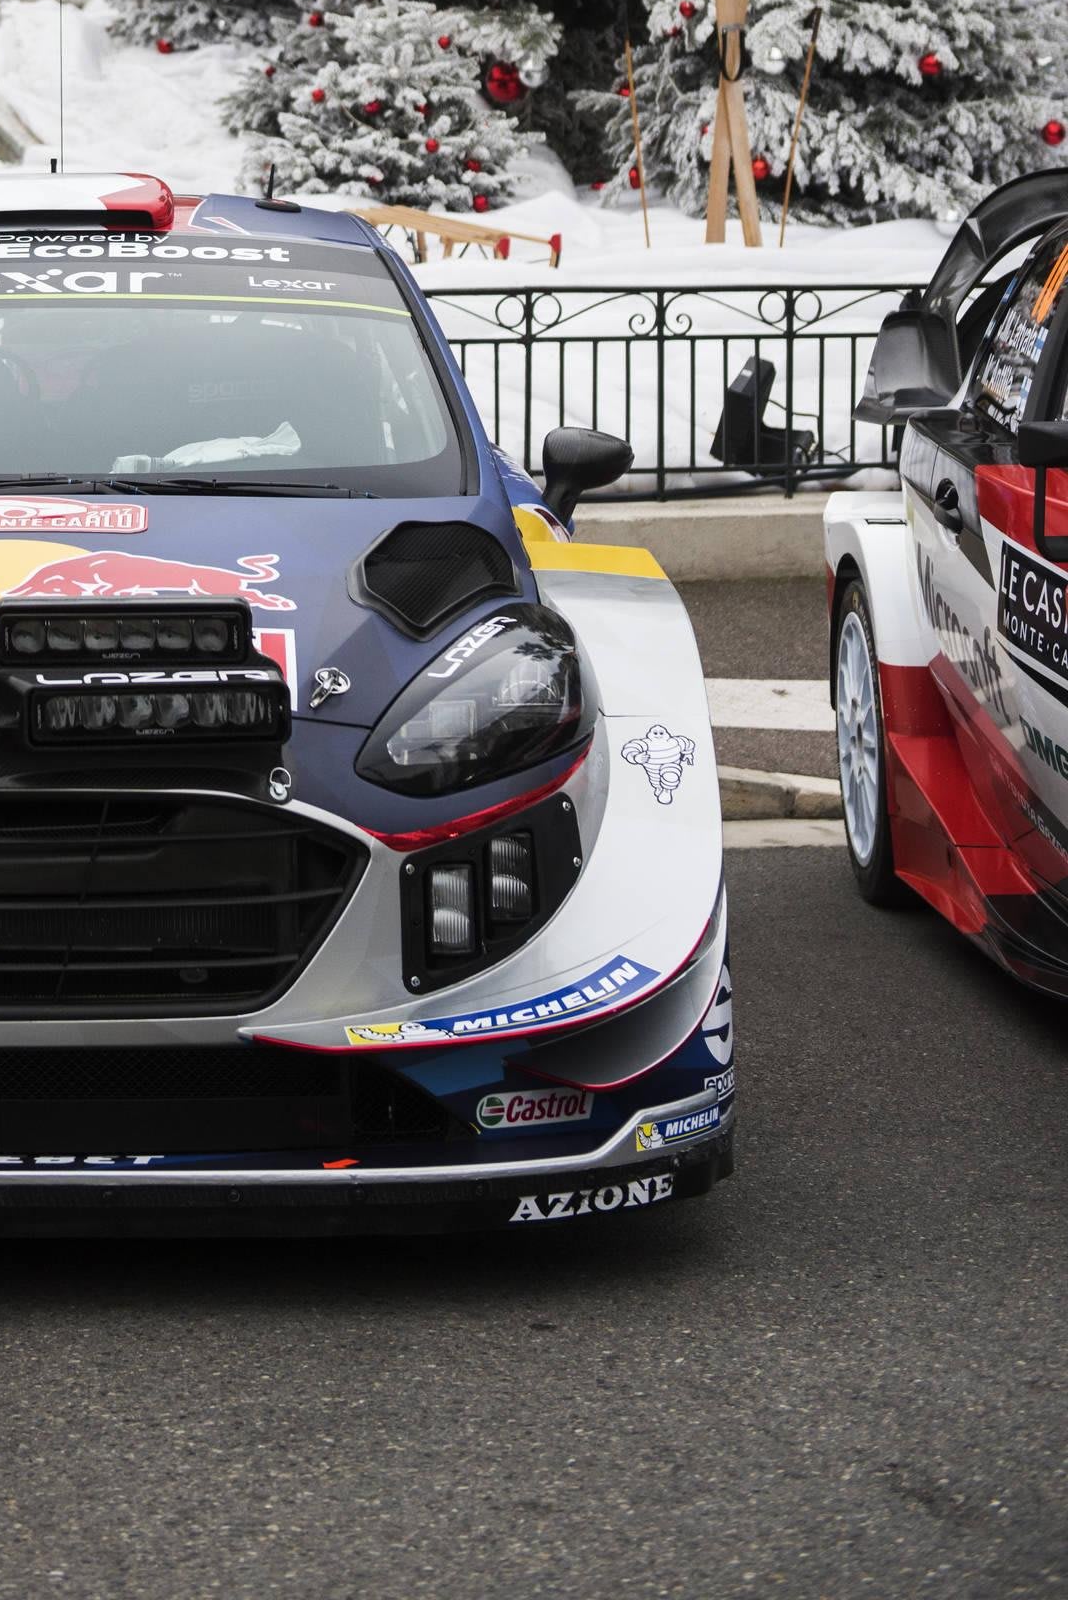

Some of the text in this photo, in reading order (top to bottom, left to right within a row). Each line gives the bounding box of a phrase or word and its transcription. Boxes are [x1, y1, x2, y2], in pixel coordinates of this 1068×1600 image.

[134, 233, 170, 244] by
[248, 275, 338, 290] Lexar
[1001, 553, 1020, 603] LE
[427, 616, 518, 679] LAZER
[916, 540, 1012, 726] Microsoft
[36, 669, 270, 685] LAZER
[453, 961, 640, 1032] MICHELIN
[505, 1091, 587, 1123] Castrol
[665, 1106, 719, 1137] MICHELIN
[509, 1172, 675, 1222] AZIONE
